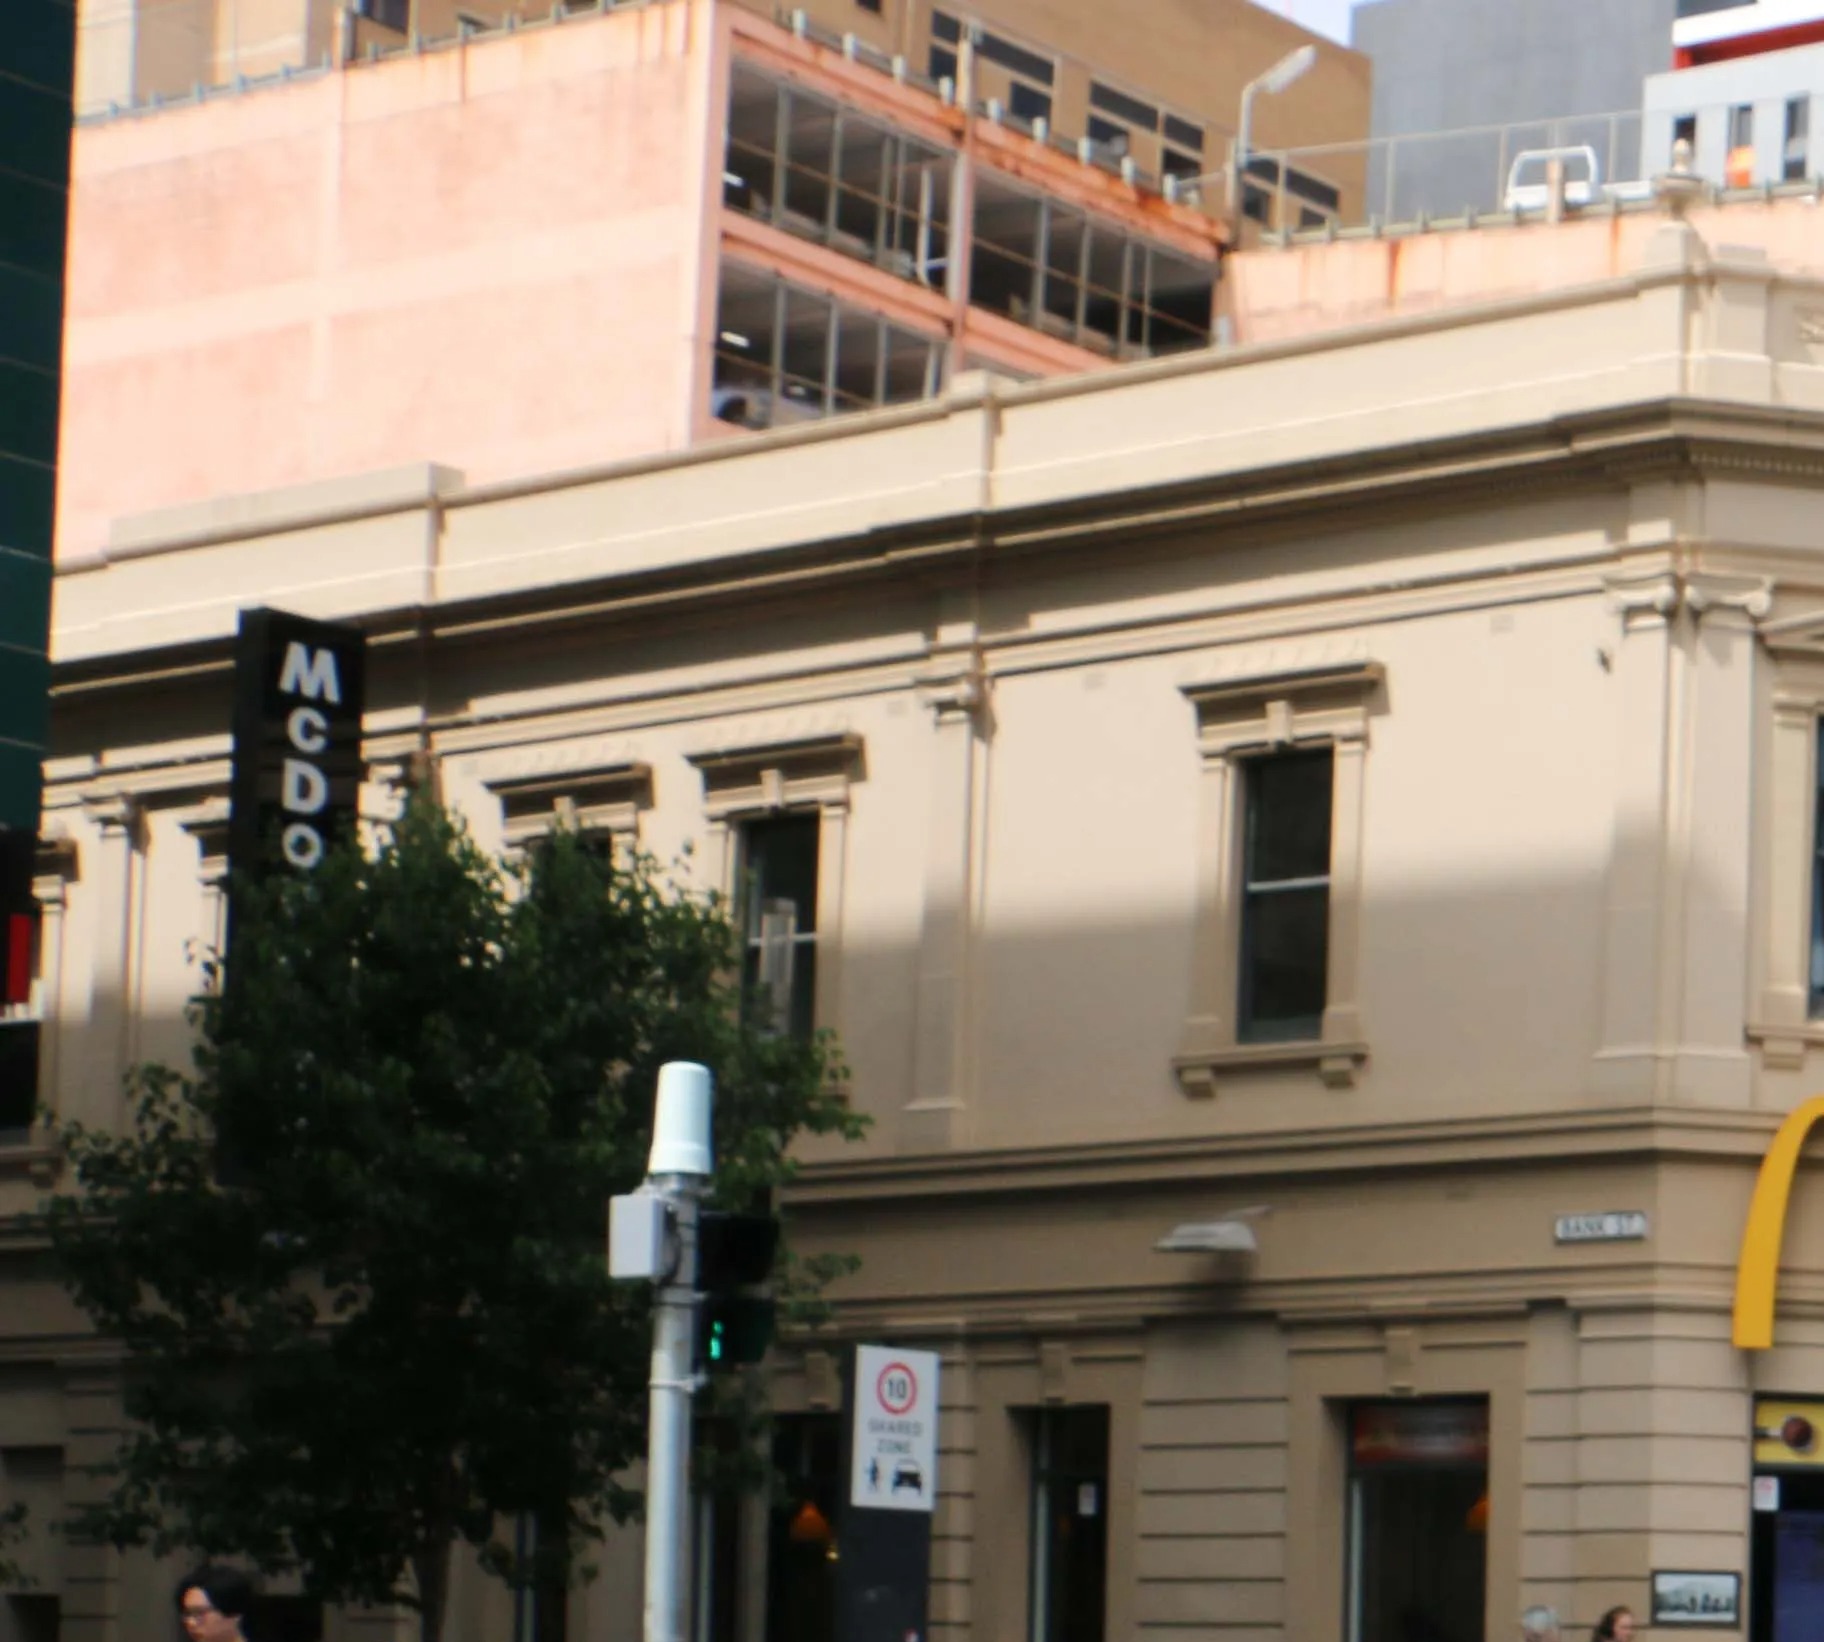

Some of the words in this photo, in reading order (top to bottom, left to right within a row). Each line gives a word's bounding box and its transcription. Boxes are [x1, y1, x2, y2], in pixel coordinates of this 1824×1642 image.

[886, 1377, 908, 1400] 10
[867, 1418, 923, 1437] SHARED
[877, 1438, 911, 1454] ZONE
